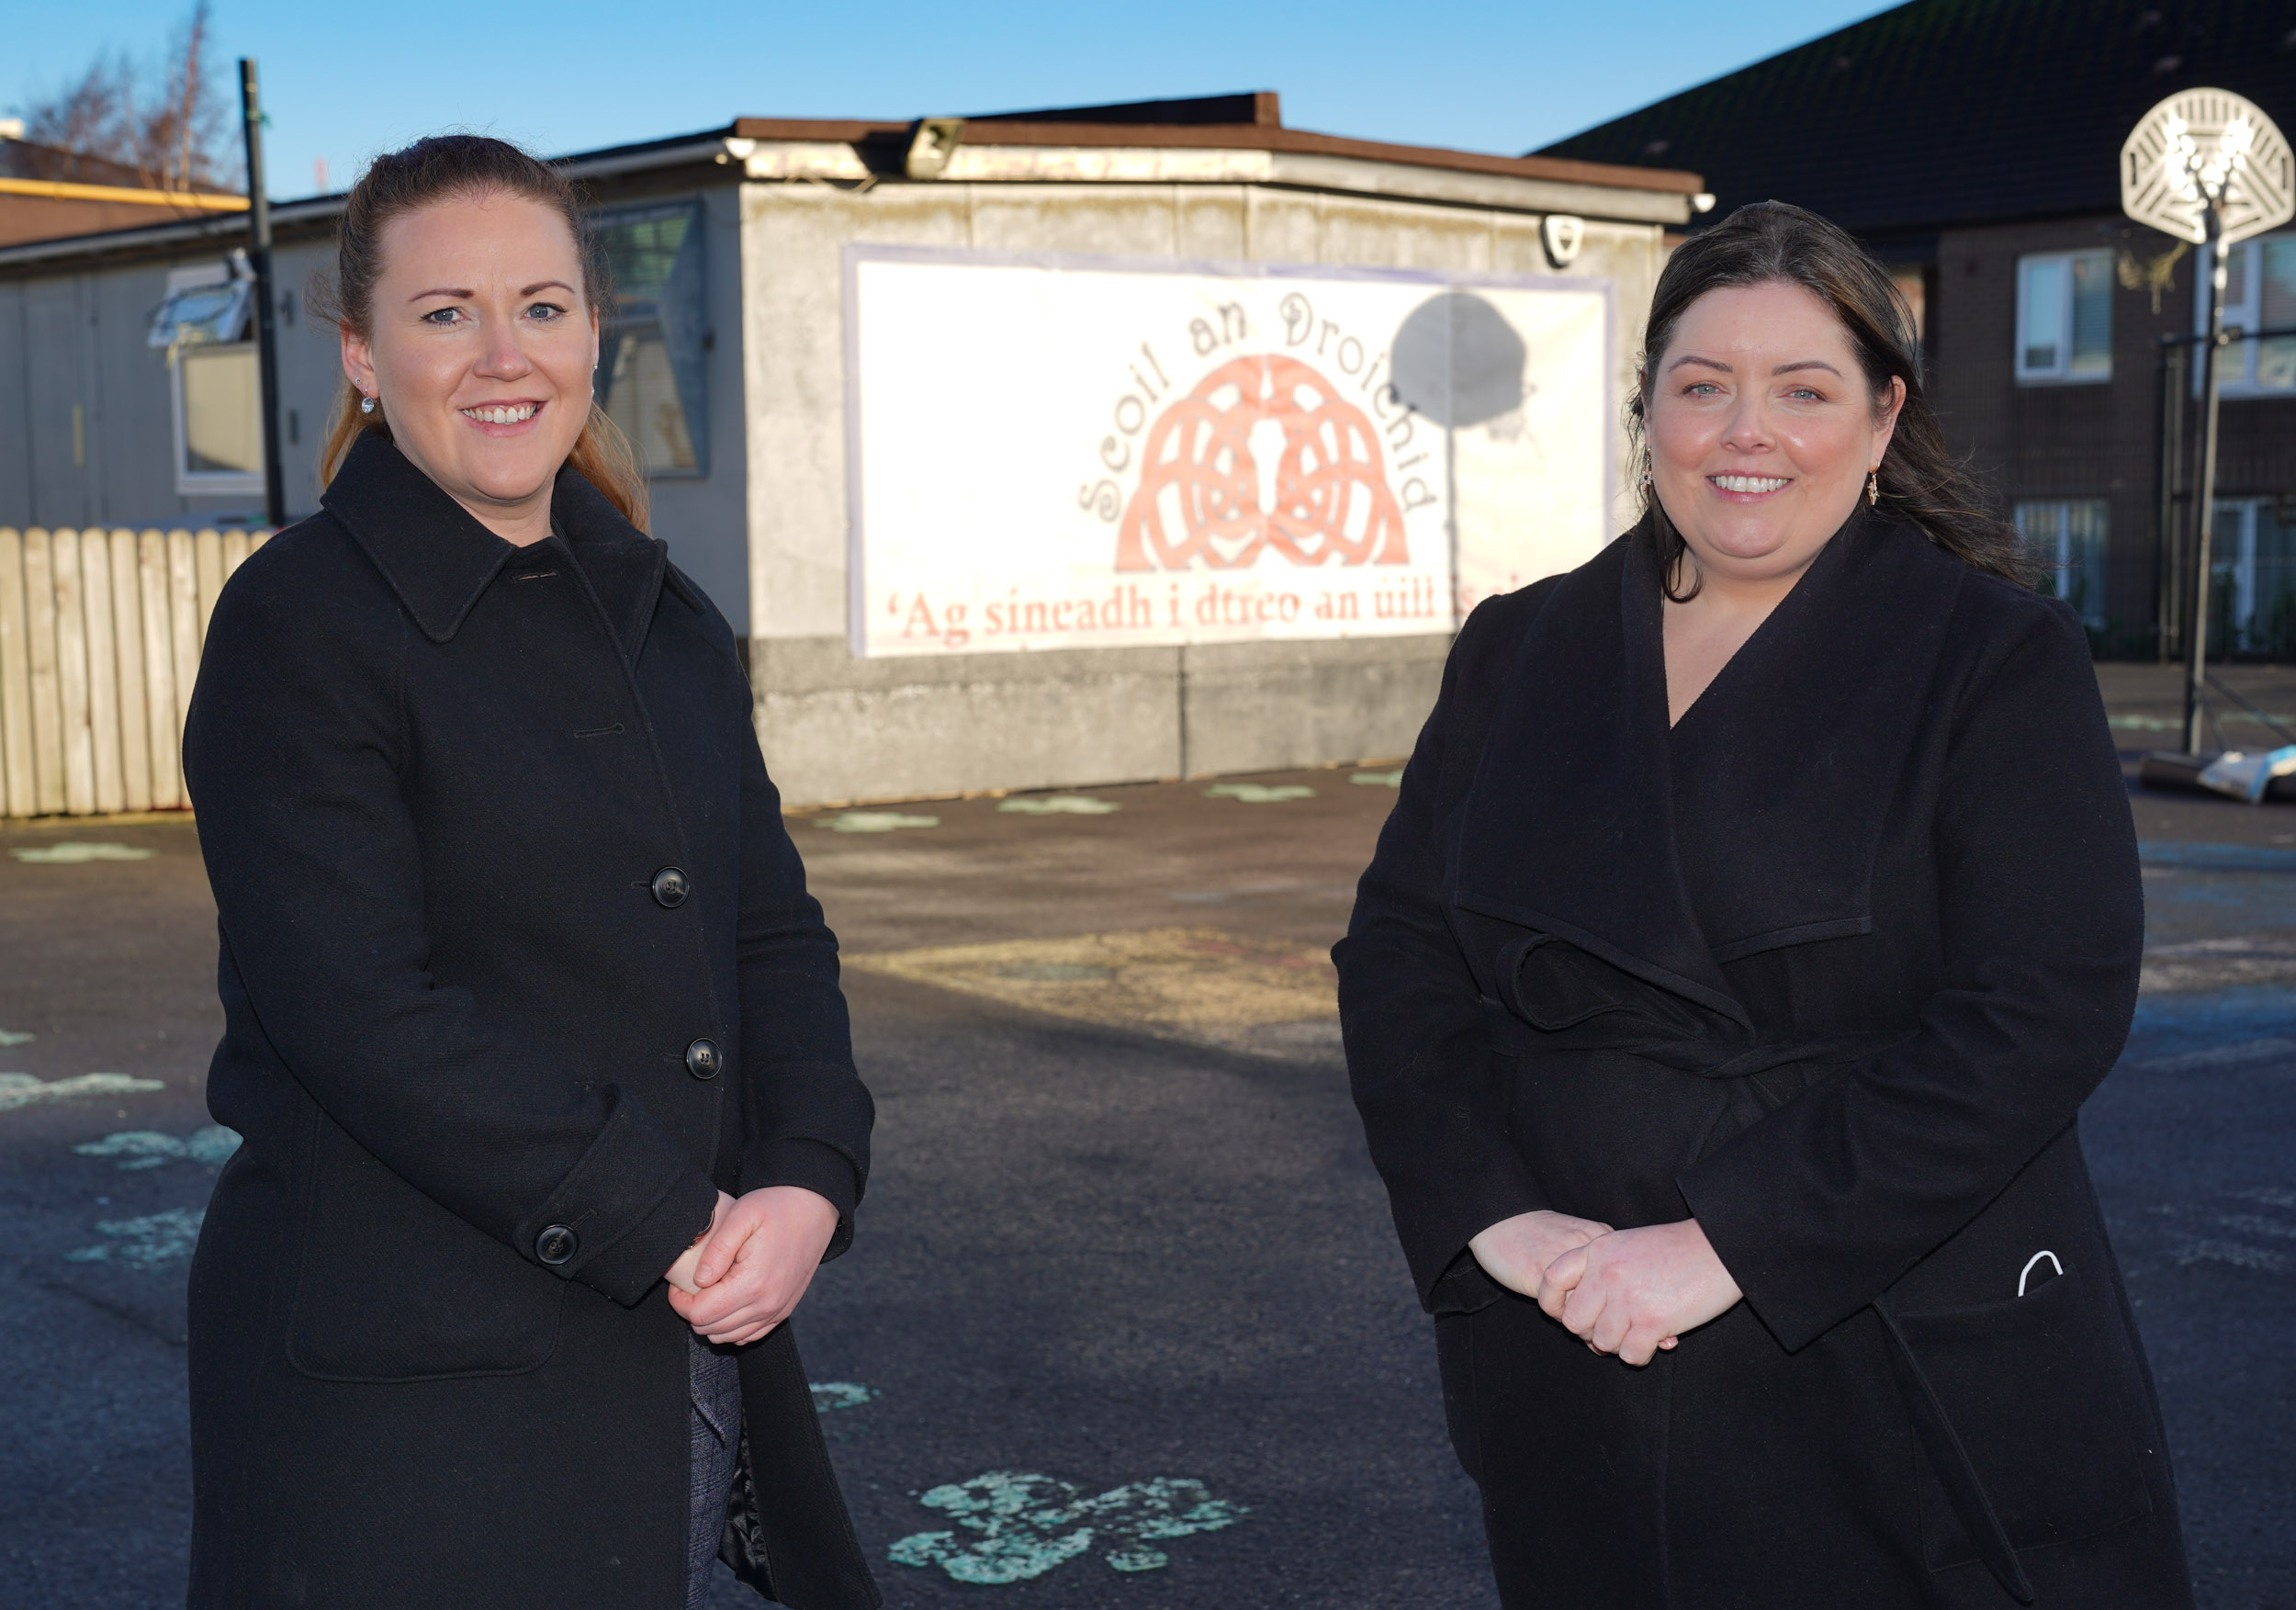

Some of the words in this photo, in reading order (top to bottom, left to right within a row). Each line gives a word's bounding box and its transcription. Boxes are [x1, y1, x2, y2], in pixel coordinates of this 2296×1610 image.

[1078, 341, 1170, 523] Scoil
[1188, 301, 1247, 357] an
[1278, 291, 1439, 514] Droichid
[985, 585, 1153, 636] síneadh
[1168, 582, 1182, 627] i
[1195, 582, 1301, 626] dtreo
[1314, 591, 1359, 621] an
